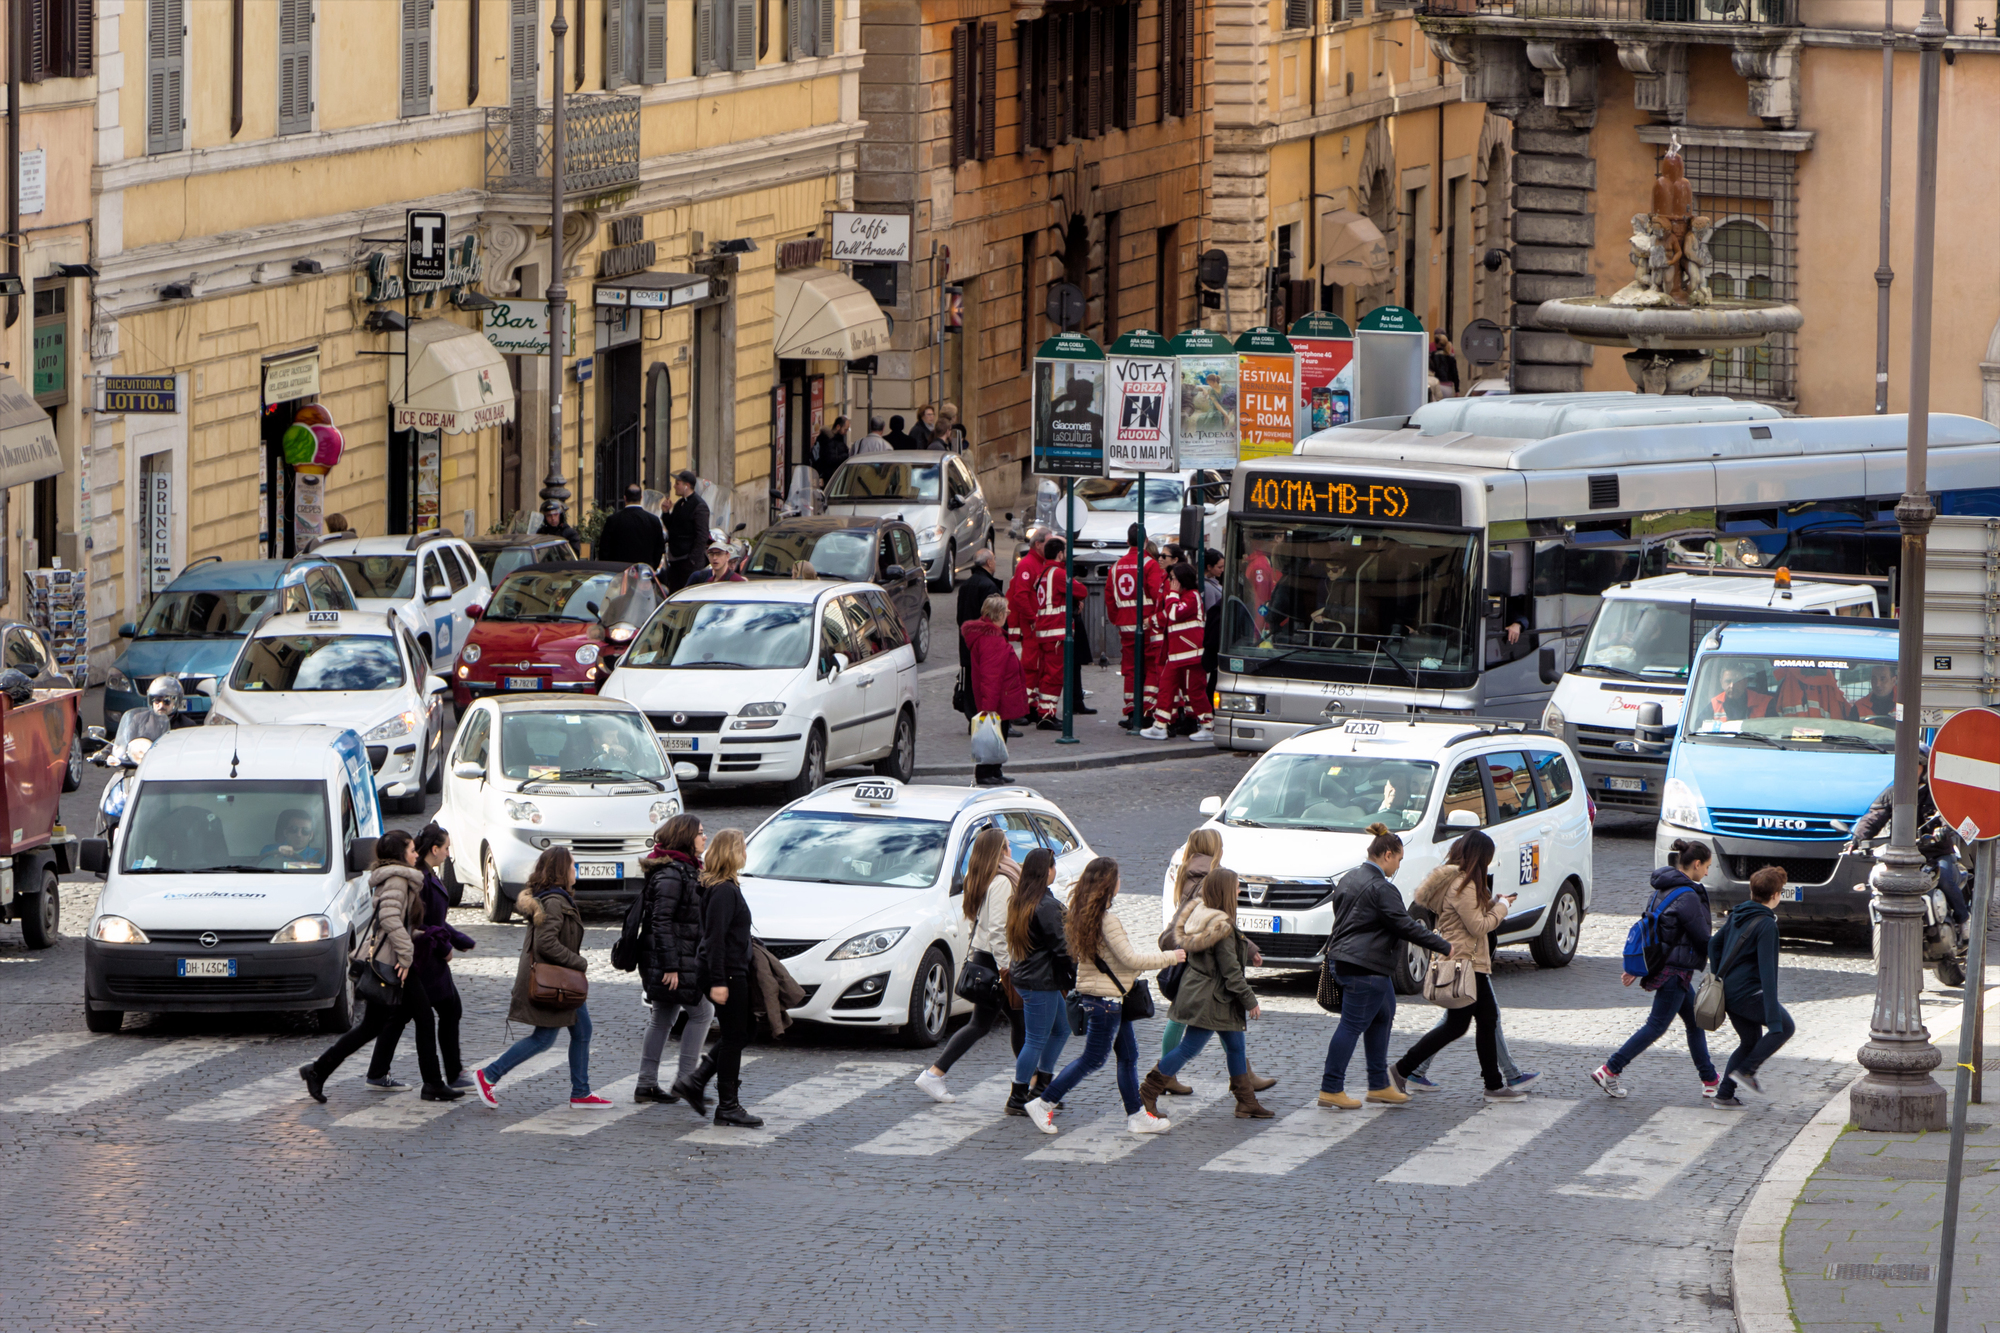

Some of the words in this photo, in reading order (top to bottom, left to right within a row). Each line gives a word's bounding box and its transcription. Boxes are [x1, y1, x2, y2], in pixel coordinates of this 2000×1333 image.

[850, 217, 889, 239] Caffè
[414, 217, 441, 257] T
[835, 241, 906, 257] Dell'Aracoeli
[636, 291, 659, 299] COVER
[486, 304, 538, 329] Bar
[801, 347, 819, 356] Bar
[821, 347, 845, 358] Rudy
[37, 354, 57, 370] LOTTO
[1117, 360, 1167, 382] VOTA
[107, 379, 161, 390] RICEVITORIA
[1126, 383, 1163, 393] FORZA
[107, 394, 159, 410] LOTTO
[1246, 394, 1286, 411] FILM
[474, 406, 493, 425] SNACK
[493, 404, 505, 419] BAR
[1122, 396, 1162, 428] FN
[399, 411, 416, 425] ICE
[419, 412, 455, 428] CREAM
[1052, 419, 1092, 430] Giacometti
[1257, 413, 1292, 427] ROMA
[1120, 430, 1158, 439] NUOVA
[1264, 431, 1292, 439] NOVEMBRE
[1110, 445, 1129, 459] ORA
[1131, 445, 1137, 459] O
[1140, 446, 1157, 459] MAI
[1250, 479, 1279, 509] 40
[156, 479, 168, 553] BRUNCH
[296, 505, 322, 513] CREPES
[310, 613, 337, 621] TAXI
[1773, 660, 1815, 668] ROMANA
[1818, 660, 1849, 669] DIESEL
[1321, 684, 1355, 696] 4463
[1345, 723, 1379, 735] TAXI
[858, 787, 891, 799] TAXI
[1757, 818, 1807, 830] IVECO
